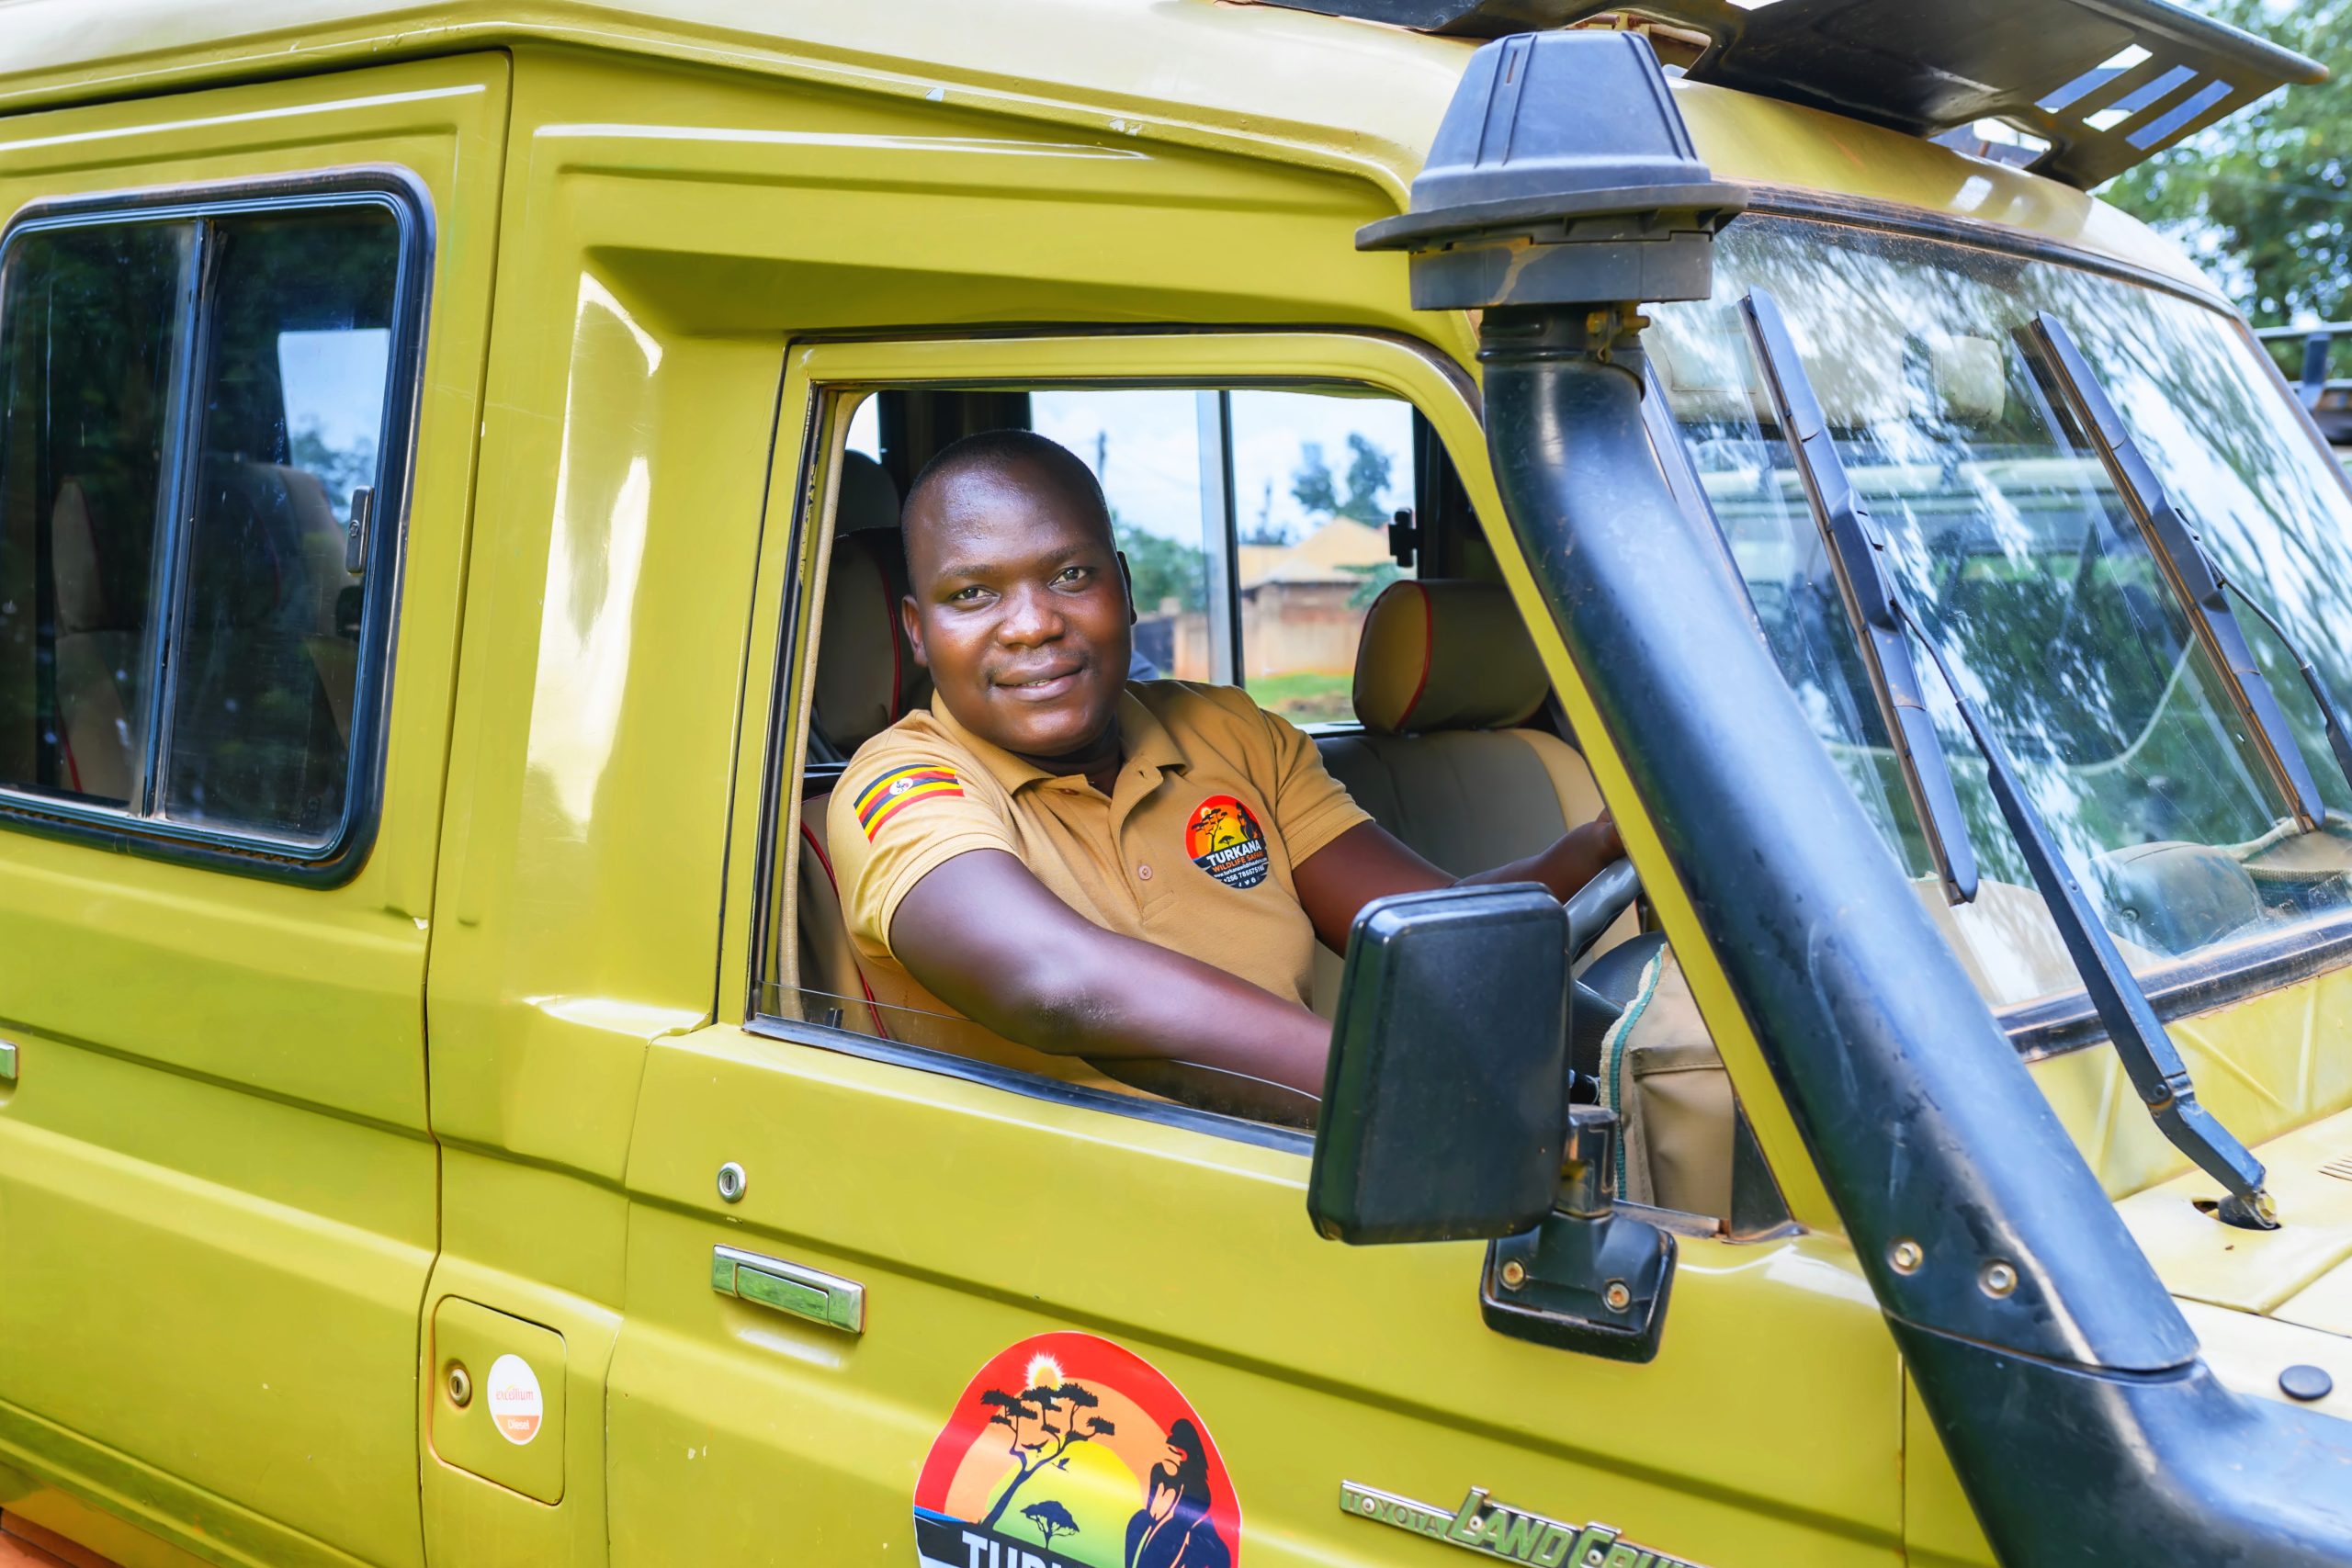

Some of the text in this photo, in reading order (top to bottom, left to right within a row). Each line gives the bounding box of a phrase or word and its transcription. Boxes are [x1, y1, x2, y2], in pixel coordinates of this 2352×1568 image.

[1206, 840, 1262, 866] TURKANA
[1212, 856, 1247, 873] WILDLIFE
[508, 1418, 530, 1430] Diesel
[1346, 1489, 1440, 1538] TOYOTA
[1443, 1486, 1573, 1567] LAND
